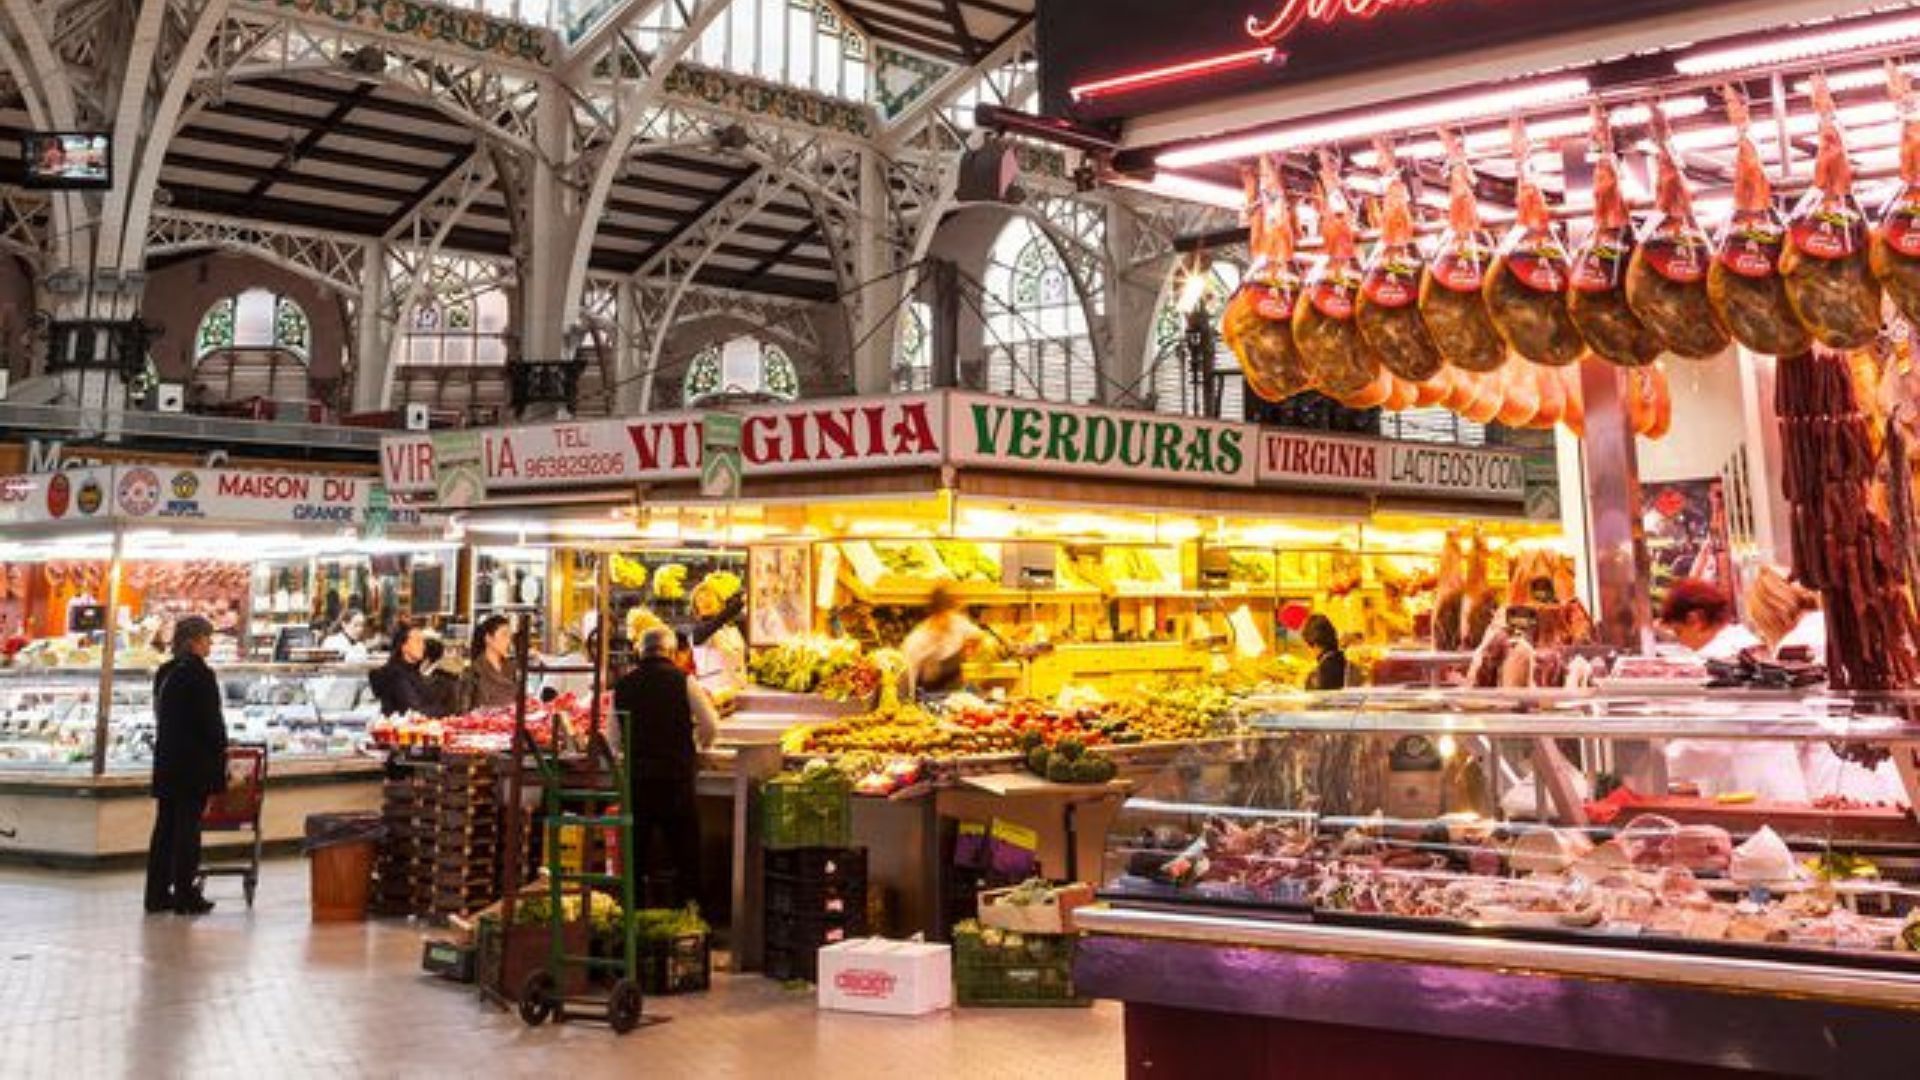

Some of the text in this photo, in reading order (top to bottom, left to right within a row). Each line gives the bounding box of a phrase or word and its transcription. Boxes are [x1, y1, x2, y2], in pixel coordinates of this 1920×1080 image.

[970, 403, 1244, 475] VERDURAS
[524, 452, 625, 478] 963829206
[1266, 436, 1377, 480] VIRGINIA
[217, 473, 355, 501] MAISON DU
[293, 503, 355, 521] GRANDE
